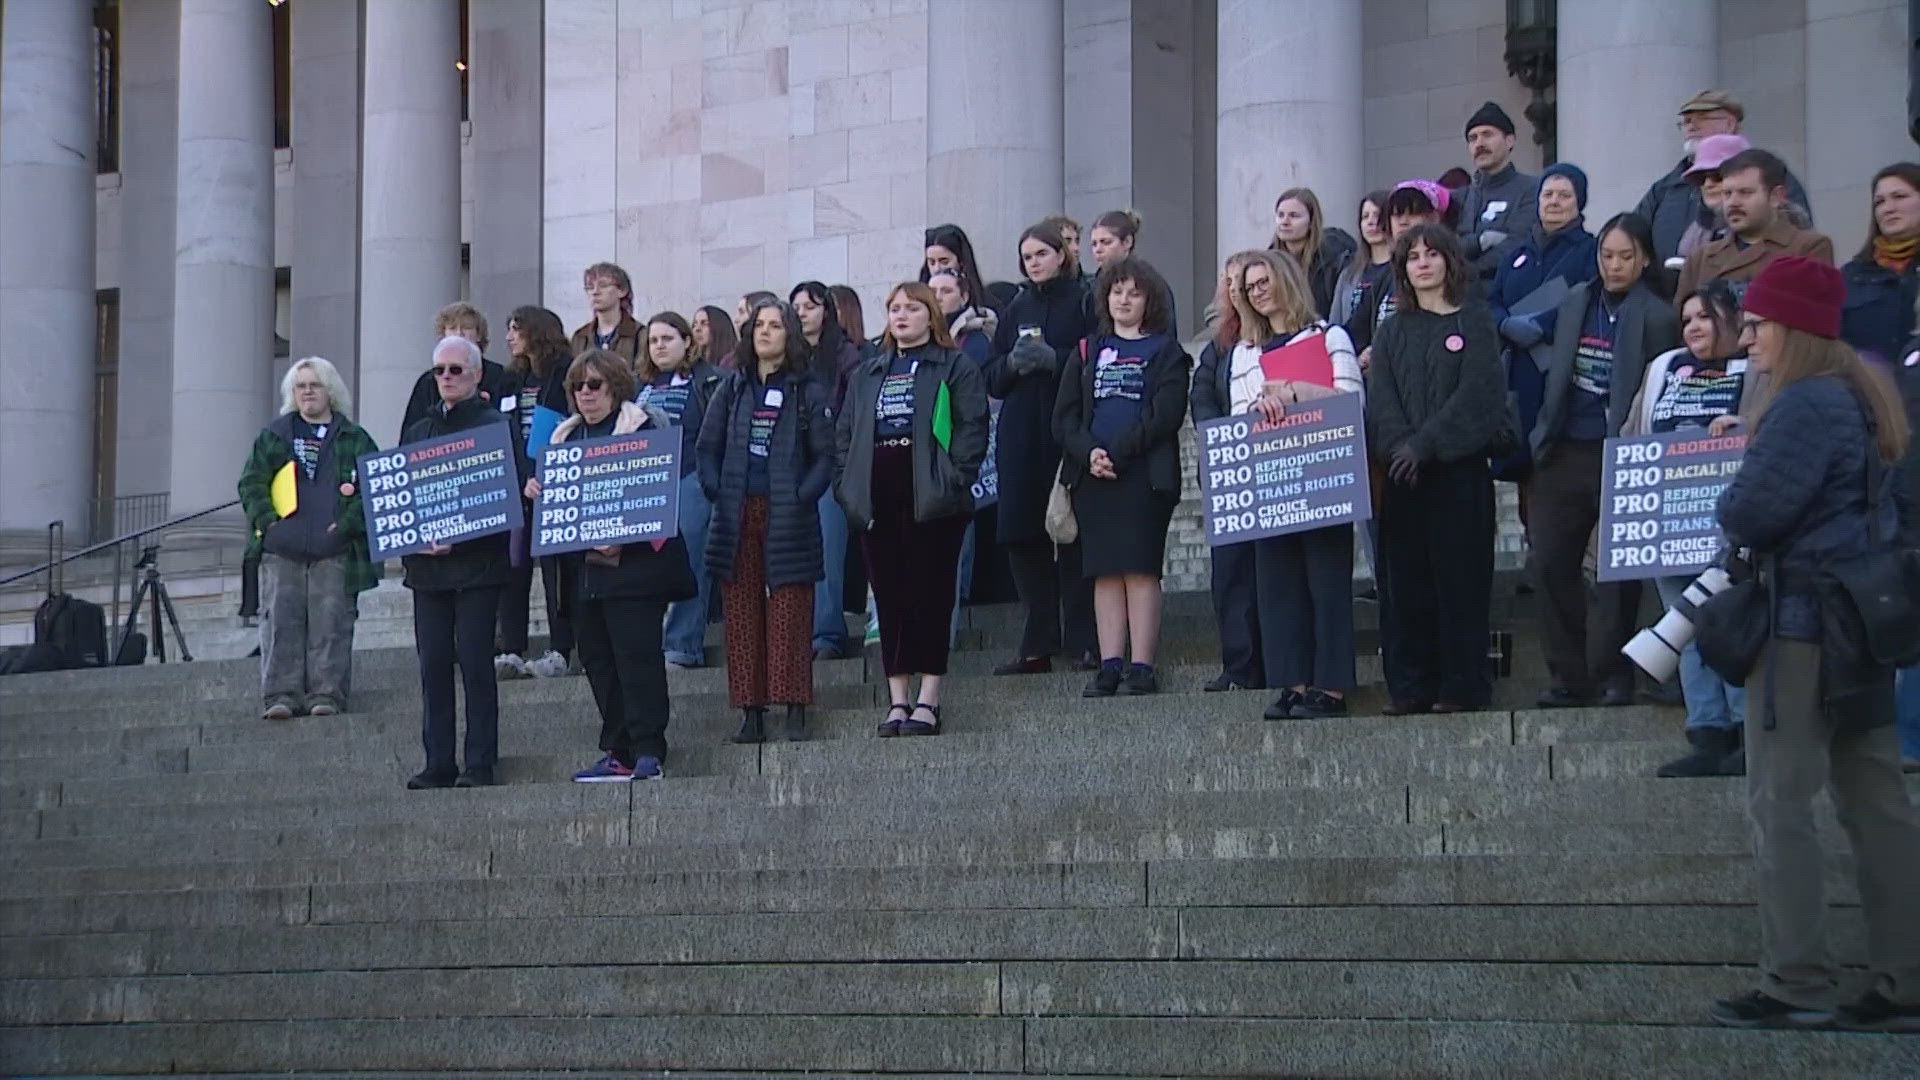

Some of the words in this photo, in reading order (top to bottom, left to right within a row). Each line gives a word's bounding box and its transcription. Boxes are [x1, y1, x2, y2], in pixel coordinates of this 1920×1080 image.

[1206, 421, 1248, 445] PRO
[1208, 444, 1250, 466] PRO
[1254, 436, 1301, 454] RACIAL
[1303, 425, 1354, 448] JUSTICE
[367, 453, 406, 475] PRO
[410, 438, 475, 462] ABORTION
[545, 447, 582, 466] PRO
[585, 440, 648, 458] ABORTION
[1616, 442, 1662, 464] PRO
[1667, 435, 1749, 456] ABORTION
[369, 471, 409, 493] PRO
[412, 462, 456, 480] RACIAL
[458, 450, 505, 471] JUSTICE
[544, 466, 581, 483] PRO
[584, 462, 625, 475] RACIAL
[627, 454, 672, 470] JUSTICE
[1210, 466, 1251, 488] PRO
[1255, 445, 1353, 473] REPRODUCTIVE
[1256, 467, 1303, 486] RIGHTS
[1614, 466, 1661, 489] PRO
[1665, 464, 1717, 480] RACIAL
[1721, 461, 1744, 476] JU
[372, 491, 411, 512] PRO
[414, 466, 505, 495] REPRODUCTIVE
[416, 487, 459, 506] RIGHTS
[543, 485, 579, 504] PRO
[583, 472, 669, 492] REPRODUCTIVE
[582, 489, 623, 502] RIGHTS
[1212, 490, 1254, 512] PRO
[1256, 483, 1301, 501] TRANS
[1305, 473, 1355, 493] RIGHTS
[1613, 493, 1659, 514] PRO
[1664, 483, 1729, 501] REPROD
[375, 511, 414, 532] PRO
[417, 501, 459, 519] TRANS
[462, 489, 507, 508] RIGHTS
[542, 507, 578, 526] PRO
[581, 502, 620, 516] TRANS
[623, 496, 667, 510] RIGHTS
[1214, 512, 1255, 535] PRO
[1258, 499, 1308, 517] CHOICE
[1259, 502, 1352, 529] WASHINGTON
[1663, 500, 1715, 515] RIGHTS
[378, 529, 417, 551] PRO
[419, 514, 465, 533] CHOICE
[420, 513, 507, 543] WASHINGTON
[540, 526, 577, 545] PRO
[580, 516, 623, 531] CHOICE
[580, 522, 662, 541] WASHINGTON
[1612, 520, 1658, 542] PRO
[1661, 518, 1712, 534] TRANS
[1610, 545, 1657, 568] PRO
[1661, 537, 1716, 552] CHOICE
